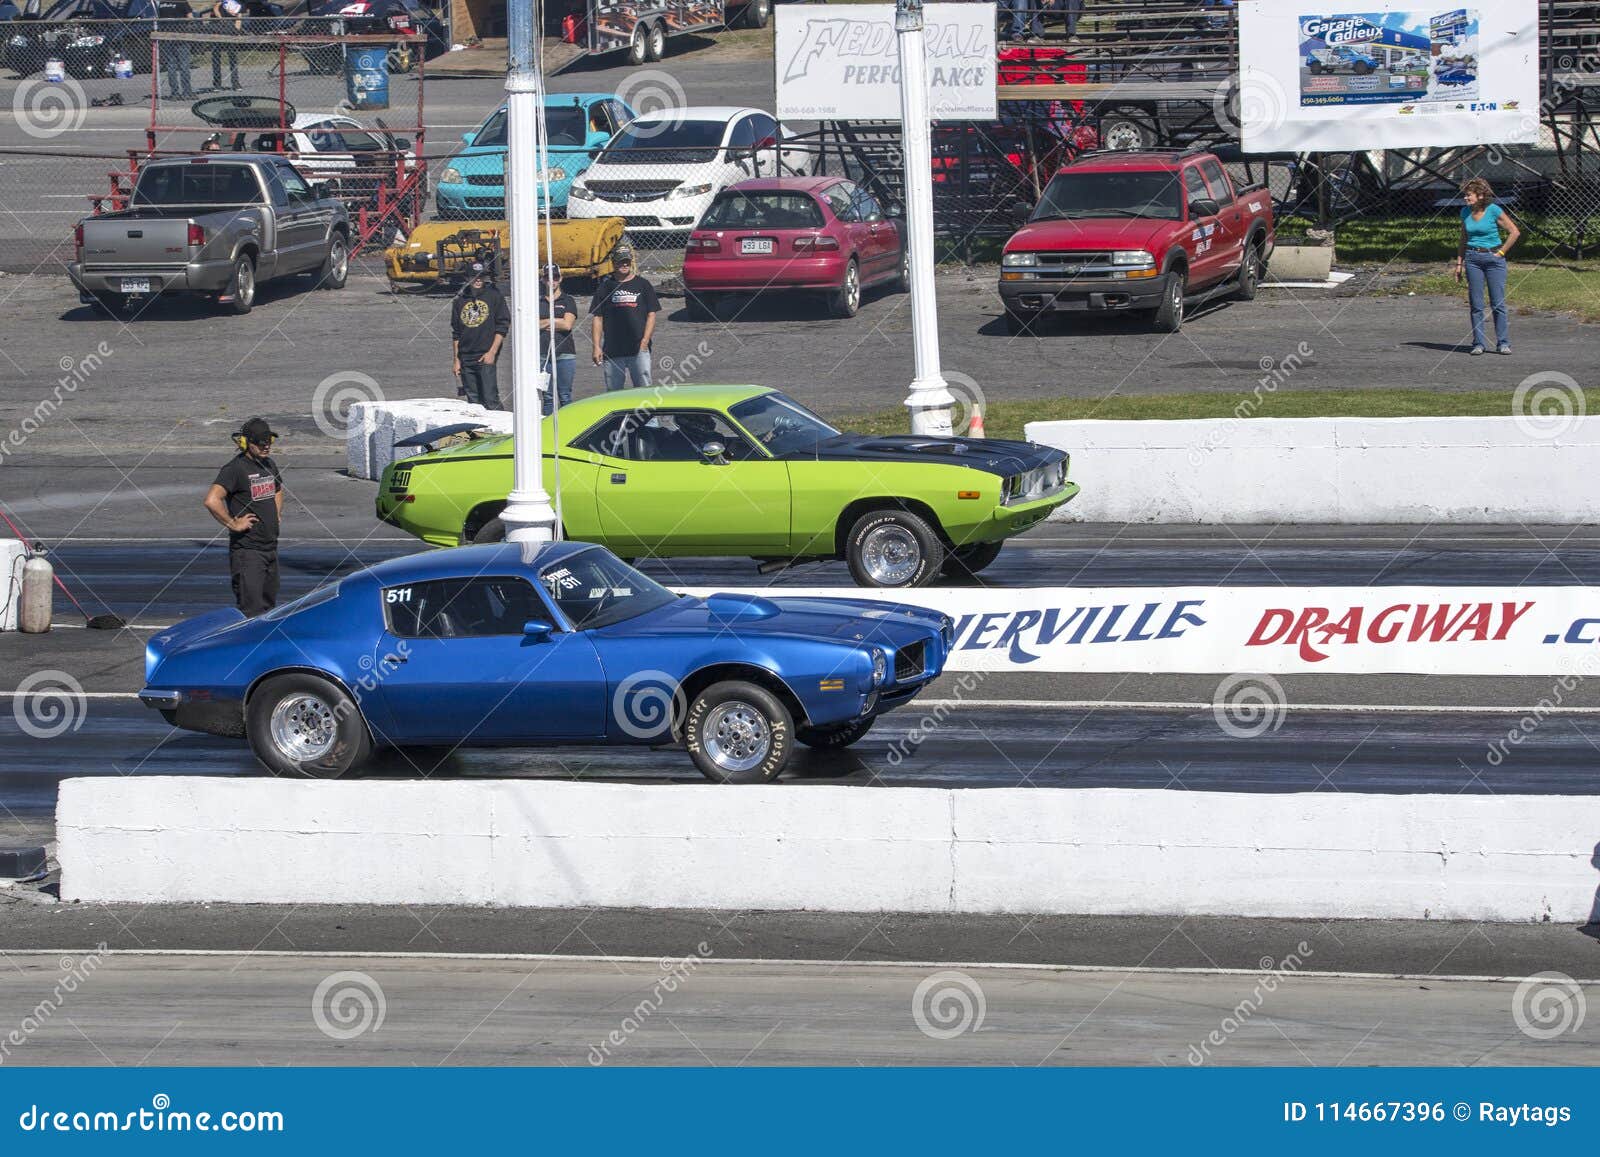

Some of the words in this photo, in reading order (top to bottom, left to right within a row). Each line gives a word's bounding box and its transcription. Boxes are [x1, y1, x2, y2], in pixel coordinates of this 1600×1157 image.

[1303, 16, 1366, 36] Garage
[1324, 26, 1384, 47] Cadieux
[842, 65, 986, 87] PERFOANCE
[546, 568, 571, 582] STREET
[560, 575, 582, 589] 511
[386, 588, 412, 603] 511
[1244, 601, 1536, 663] DRAGWAY
[688, 699, 708, 753] Hoosier
[762, 720, 786, 775] Hoosier
